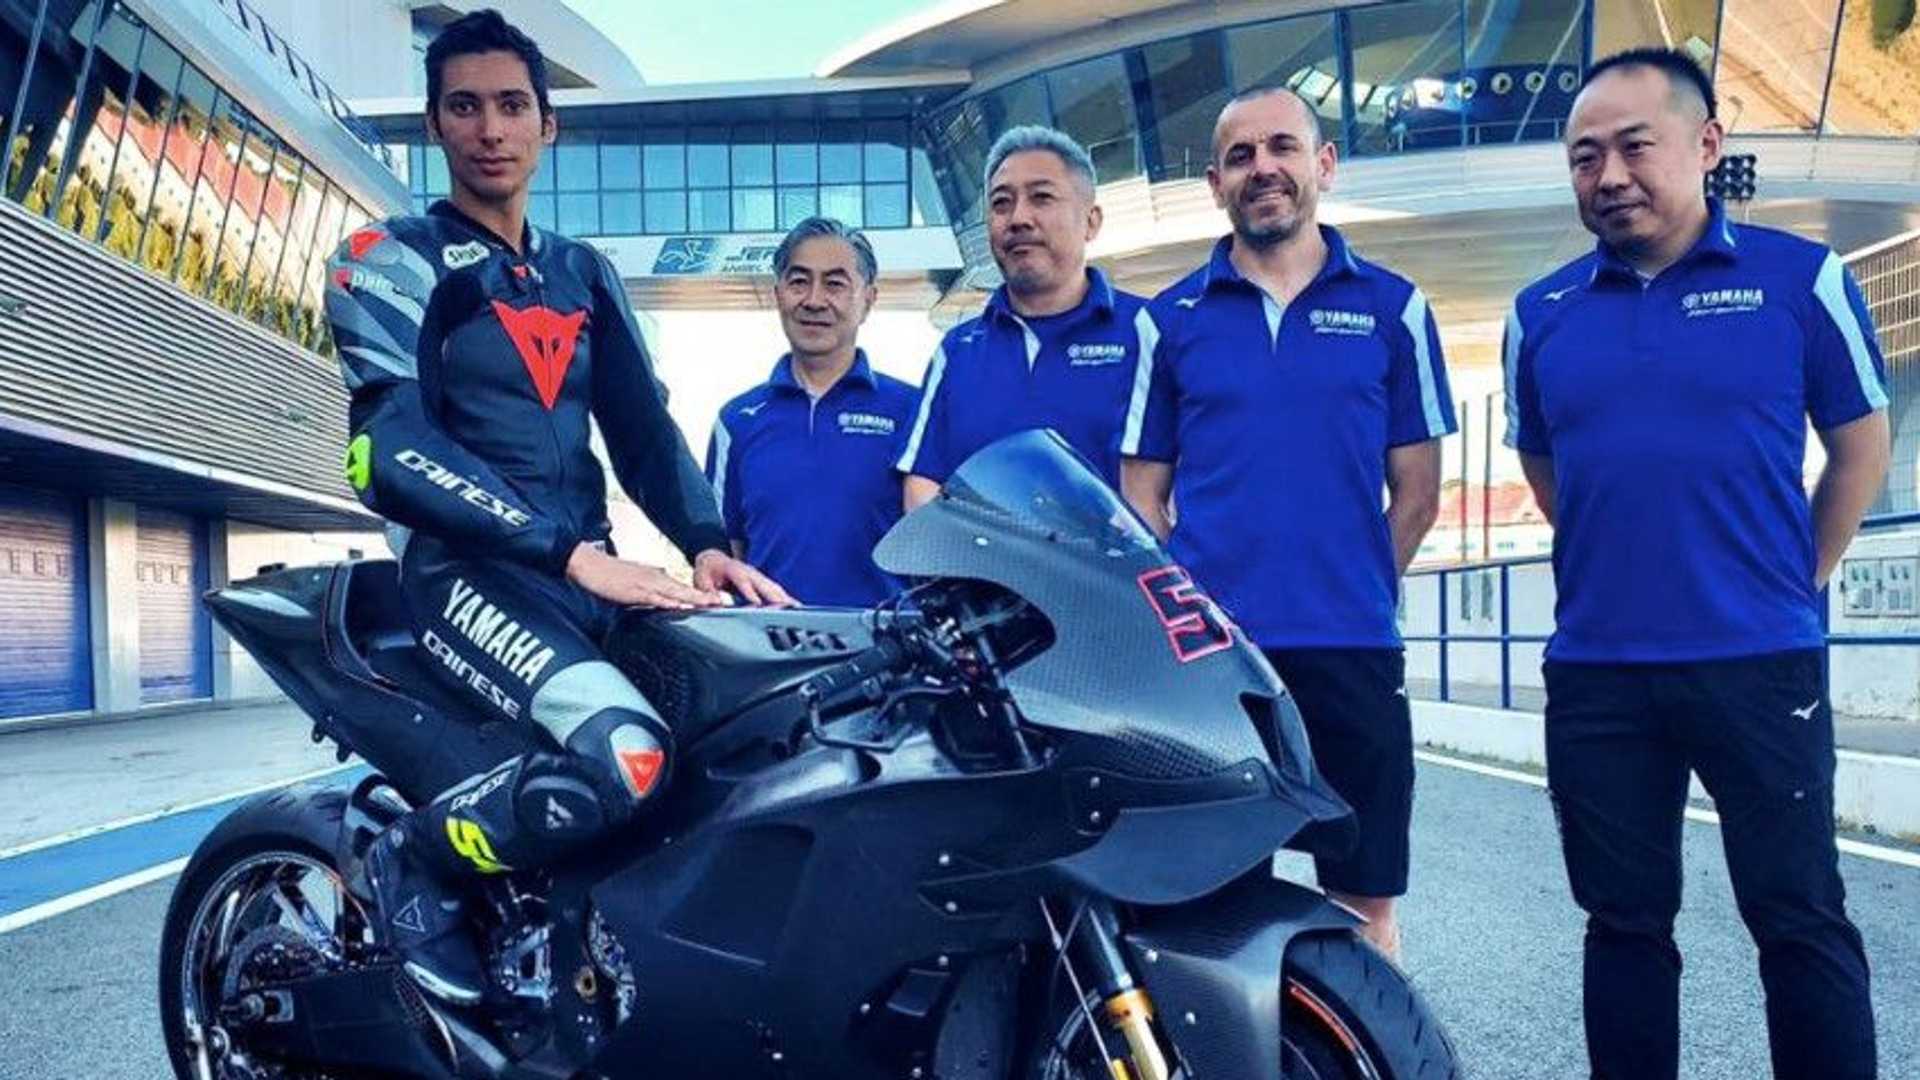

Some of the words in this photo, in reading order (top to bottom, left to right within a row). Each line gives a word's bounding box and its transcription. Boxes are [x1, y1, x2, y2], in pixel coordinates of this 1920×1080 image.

[1702, 288, 1764, 308] YAMAHA
[1325, 309, 1376, 329] YAMAHA
[1081, 344, 1126, 359] YAMAHA
[852, 413, 895, 432] YAMAHA
[394, 448, 533, 528] DAINESE
[442, 577, 556, 686] YAMAHA
[421, 629, 522, 721] DAINESE
